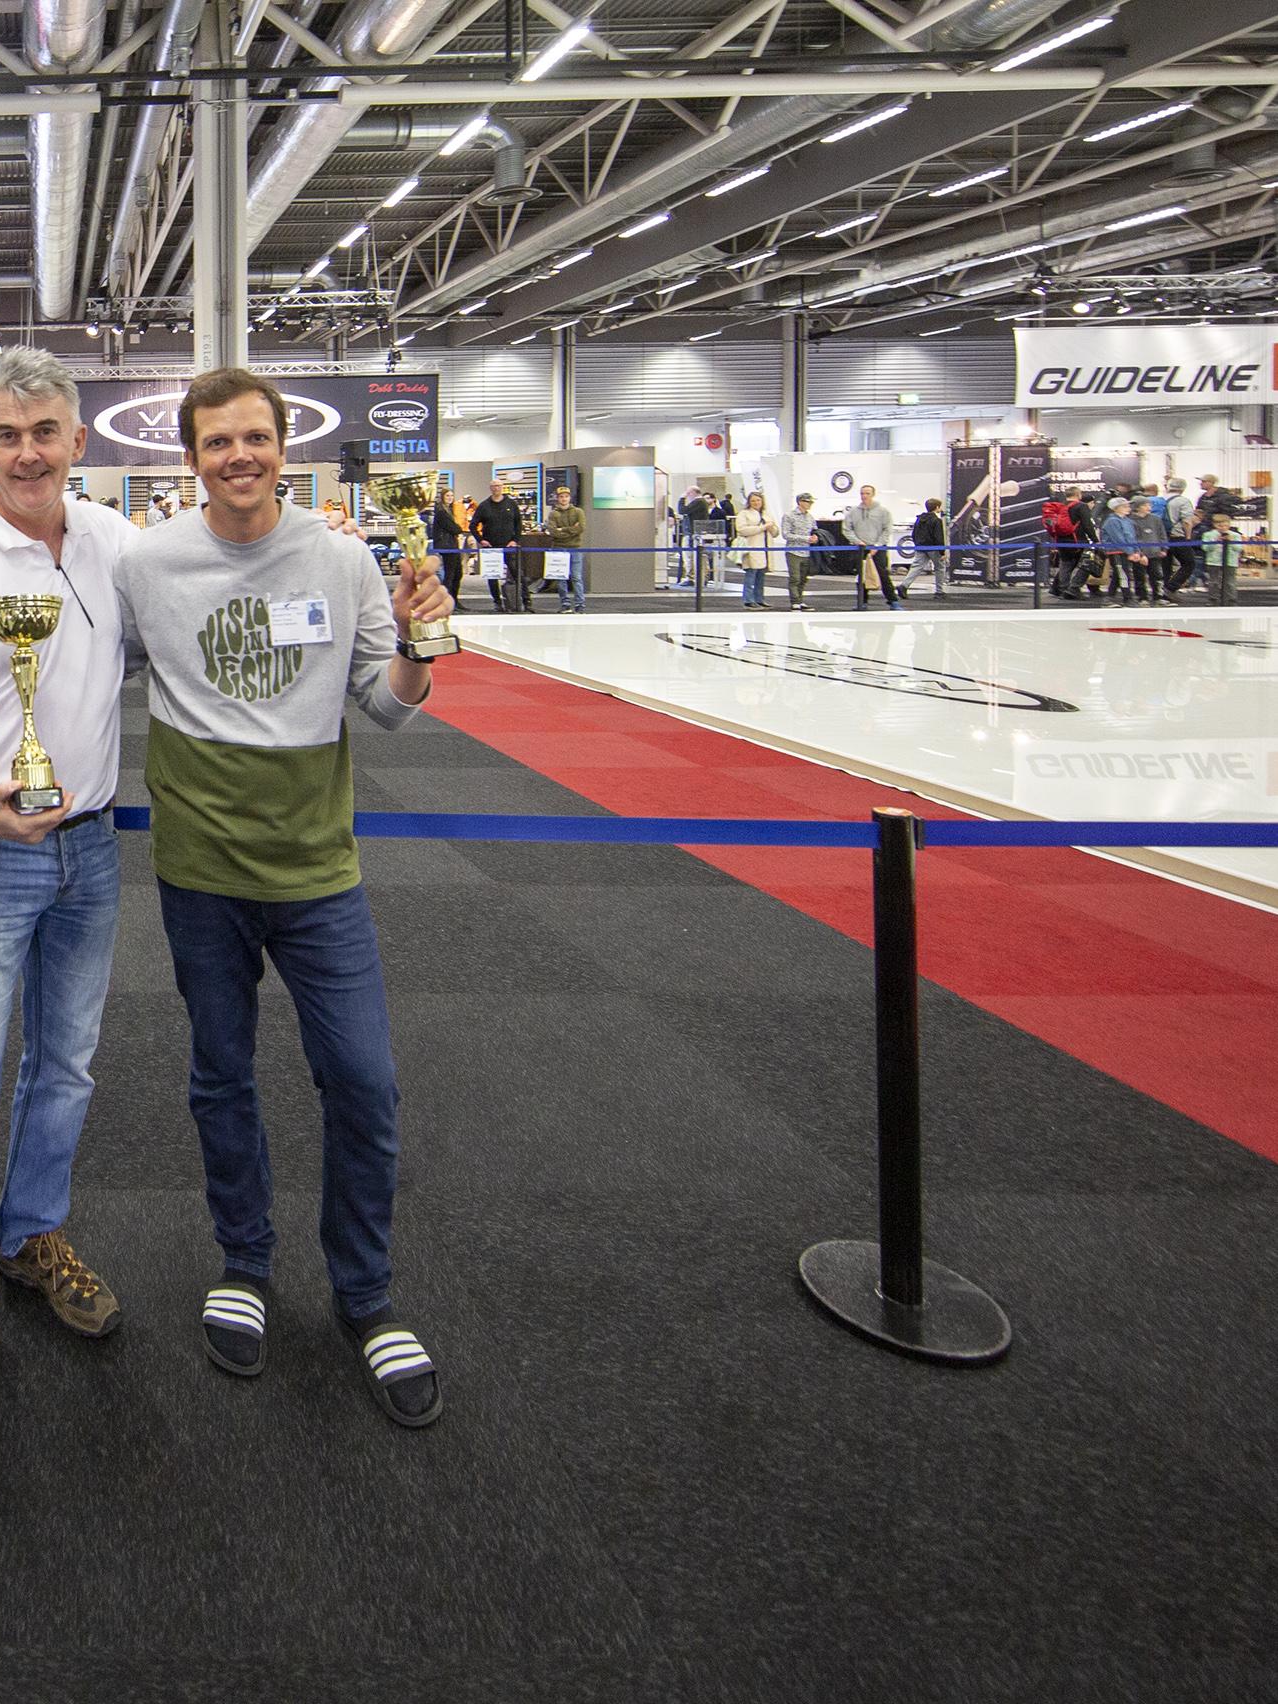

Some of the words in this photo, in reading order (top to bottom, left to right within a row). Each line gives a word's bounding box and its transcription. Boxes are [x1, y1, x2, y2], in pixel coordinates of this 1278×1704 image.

[1029, 364, 1262, 395] GUIDELINE
[138, 431, 178, 439] FLY
[369, 439, 430, 454] COSTA
